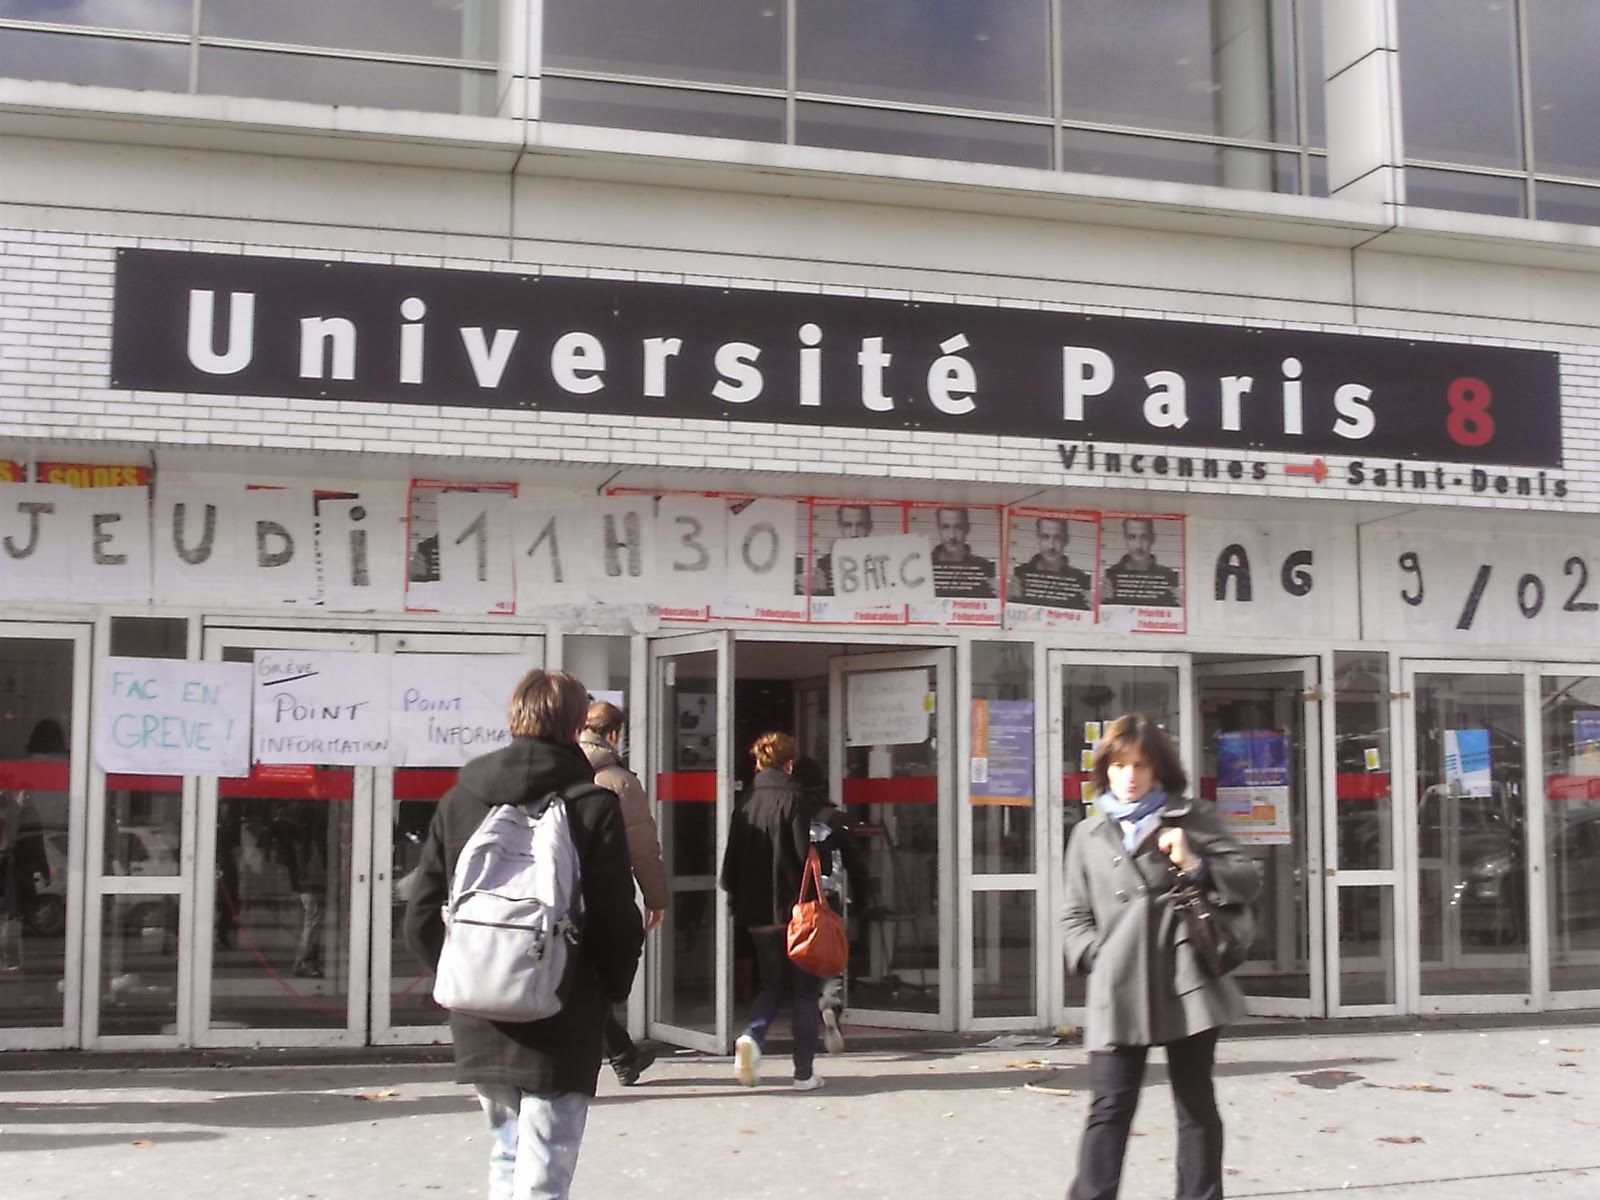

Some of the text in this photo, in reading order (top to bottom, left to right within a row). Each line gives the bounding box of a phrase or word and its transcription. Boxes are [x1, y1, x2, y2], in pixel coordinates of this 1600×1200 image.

[186, 289, 1496, 447] Université Paris 8
[1057, 444, 1568, 498] Vincennes Saint-Denis
[1214, 542, 1314, 602] AG
[1398, 551, 1599, 630] 9/02
[111, 671, 219, 704] FAC EN
[112, 713, 212, 751] GREVE
